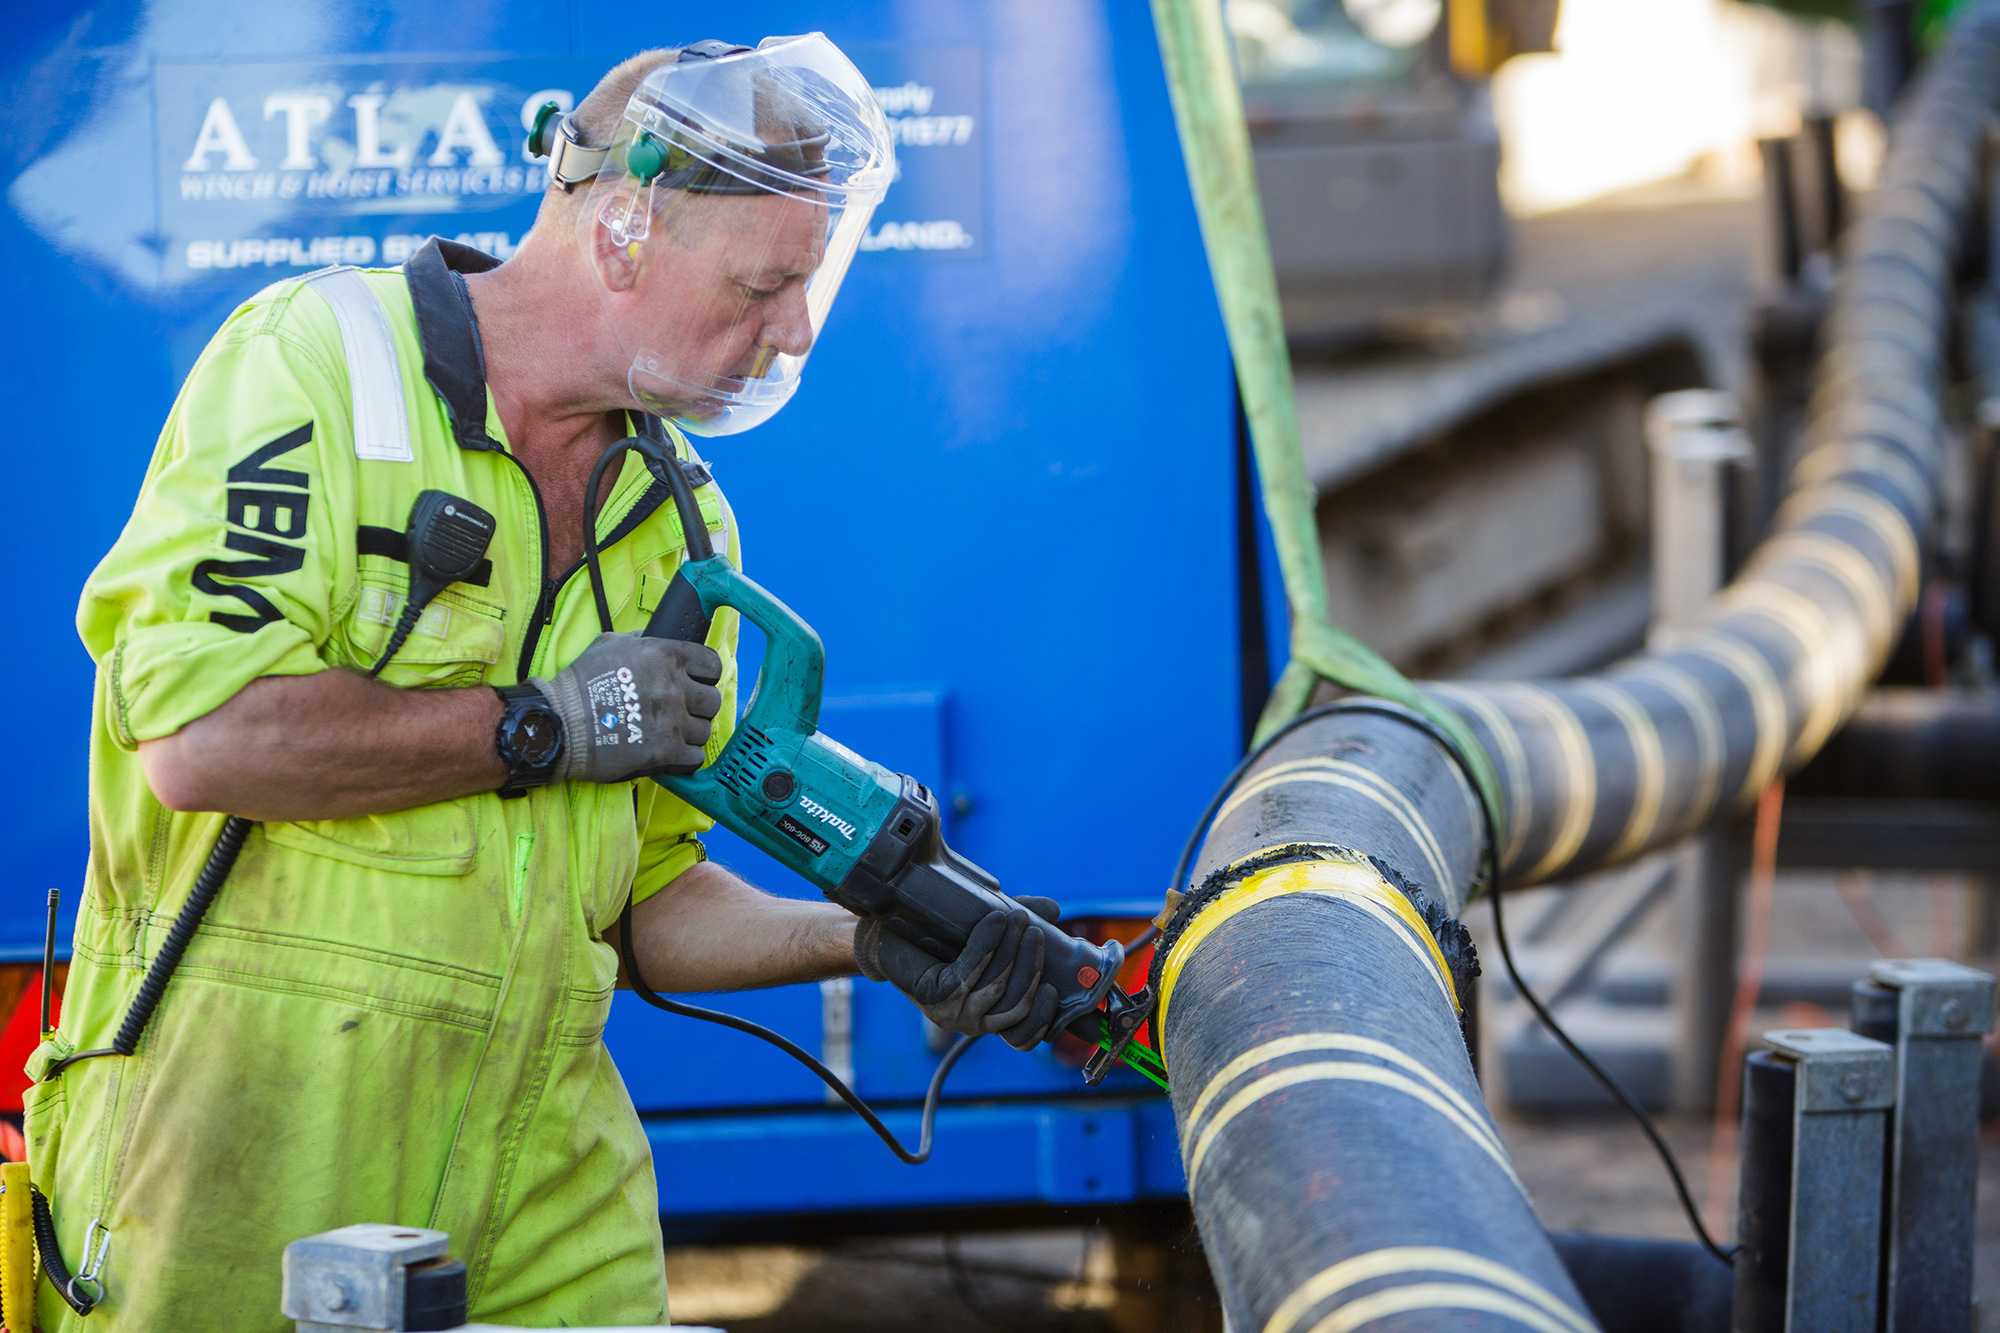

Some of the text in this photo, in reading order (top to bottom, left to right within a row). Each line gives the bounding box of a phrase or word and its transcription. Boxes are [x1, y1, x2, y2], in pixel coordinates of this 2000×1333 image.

[180, 173, 276, 200] WINCH
[307, 169, 393, 199] HOIST
[186, 234, 376, 269] SUPPLIED
[455, 511, 488, 530] MOTOROLA
[616, 667, 643, 744] OXXA
